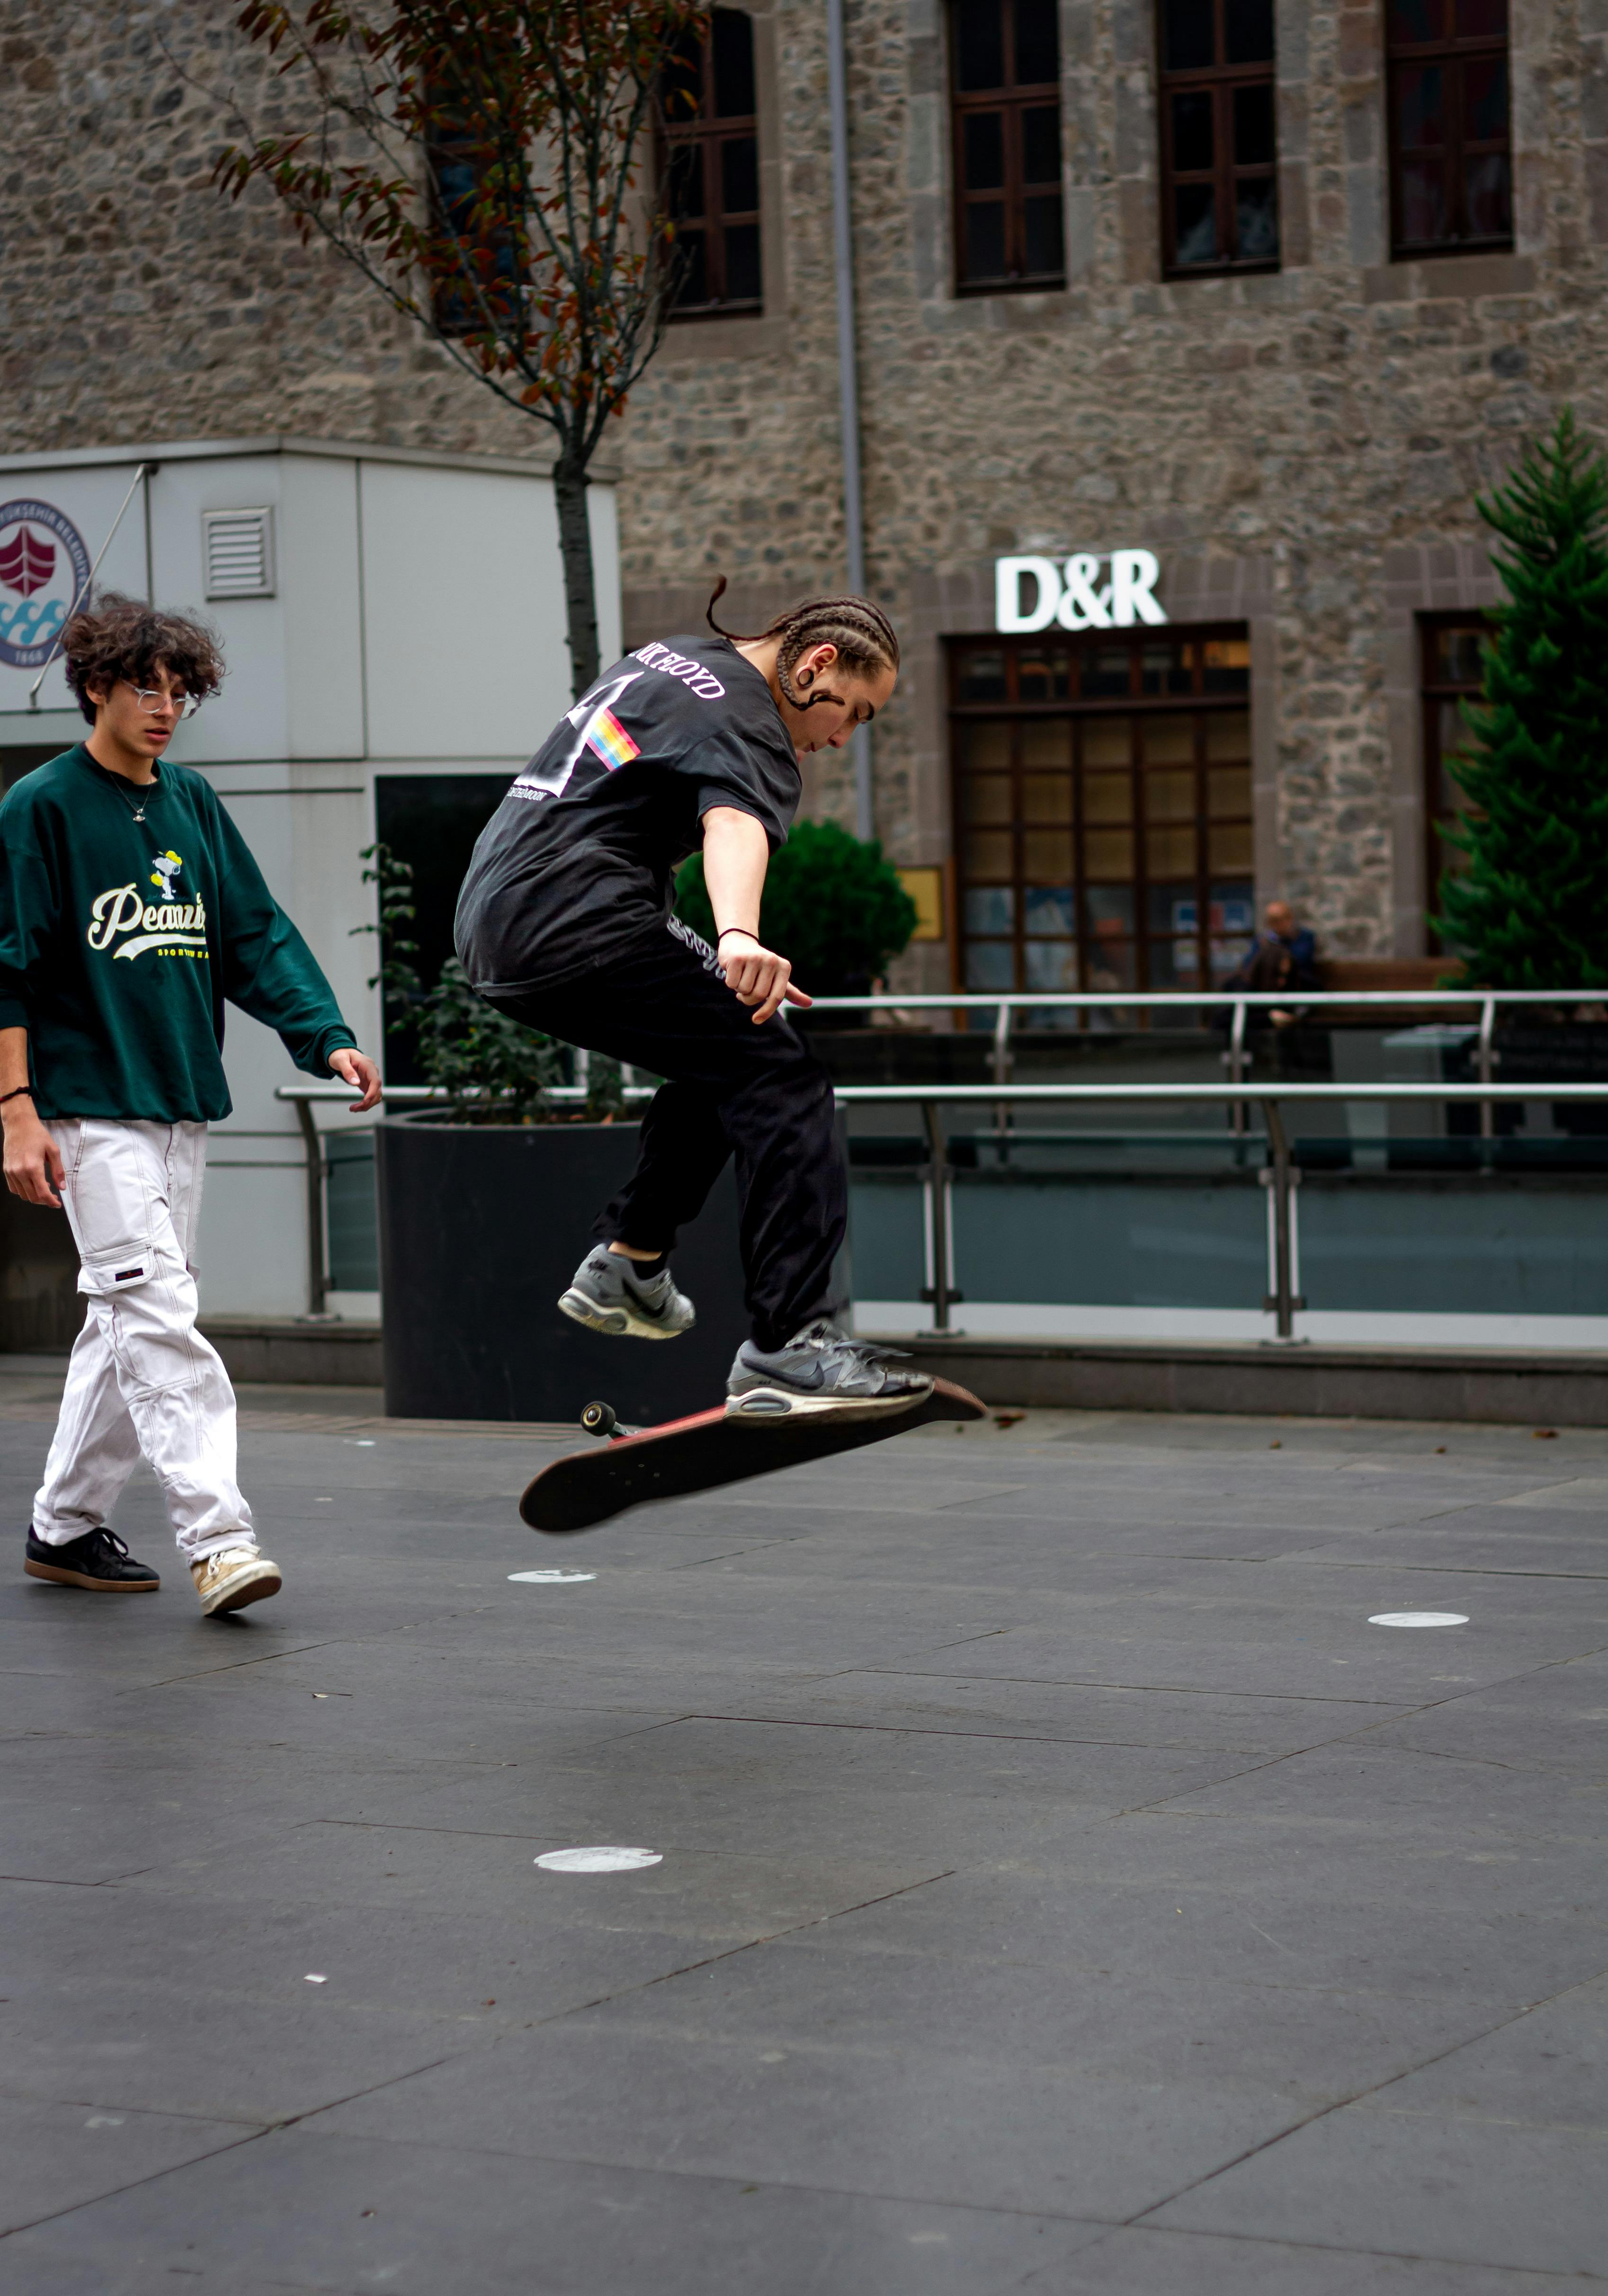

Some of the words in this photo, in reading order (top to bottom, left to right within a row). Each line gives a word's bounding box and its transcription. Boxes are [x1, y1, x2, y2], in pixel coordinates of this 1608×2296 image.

[995, 548, 1169, 634] D&R
[650, 652, 726, 699] FLOYD
[523, 788, 548, 802] MOON
